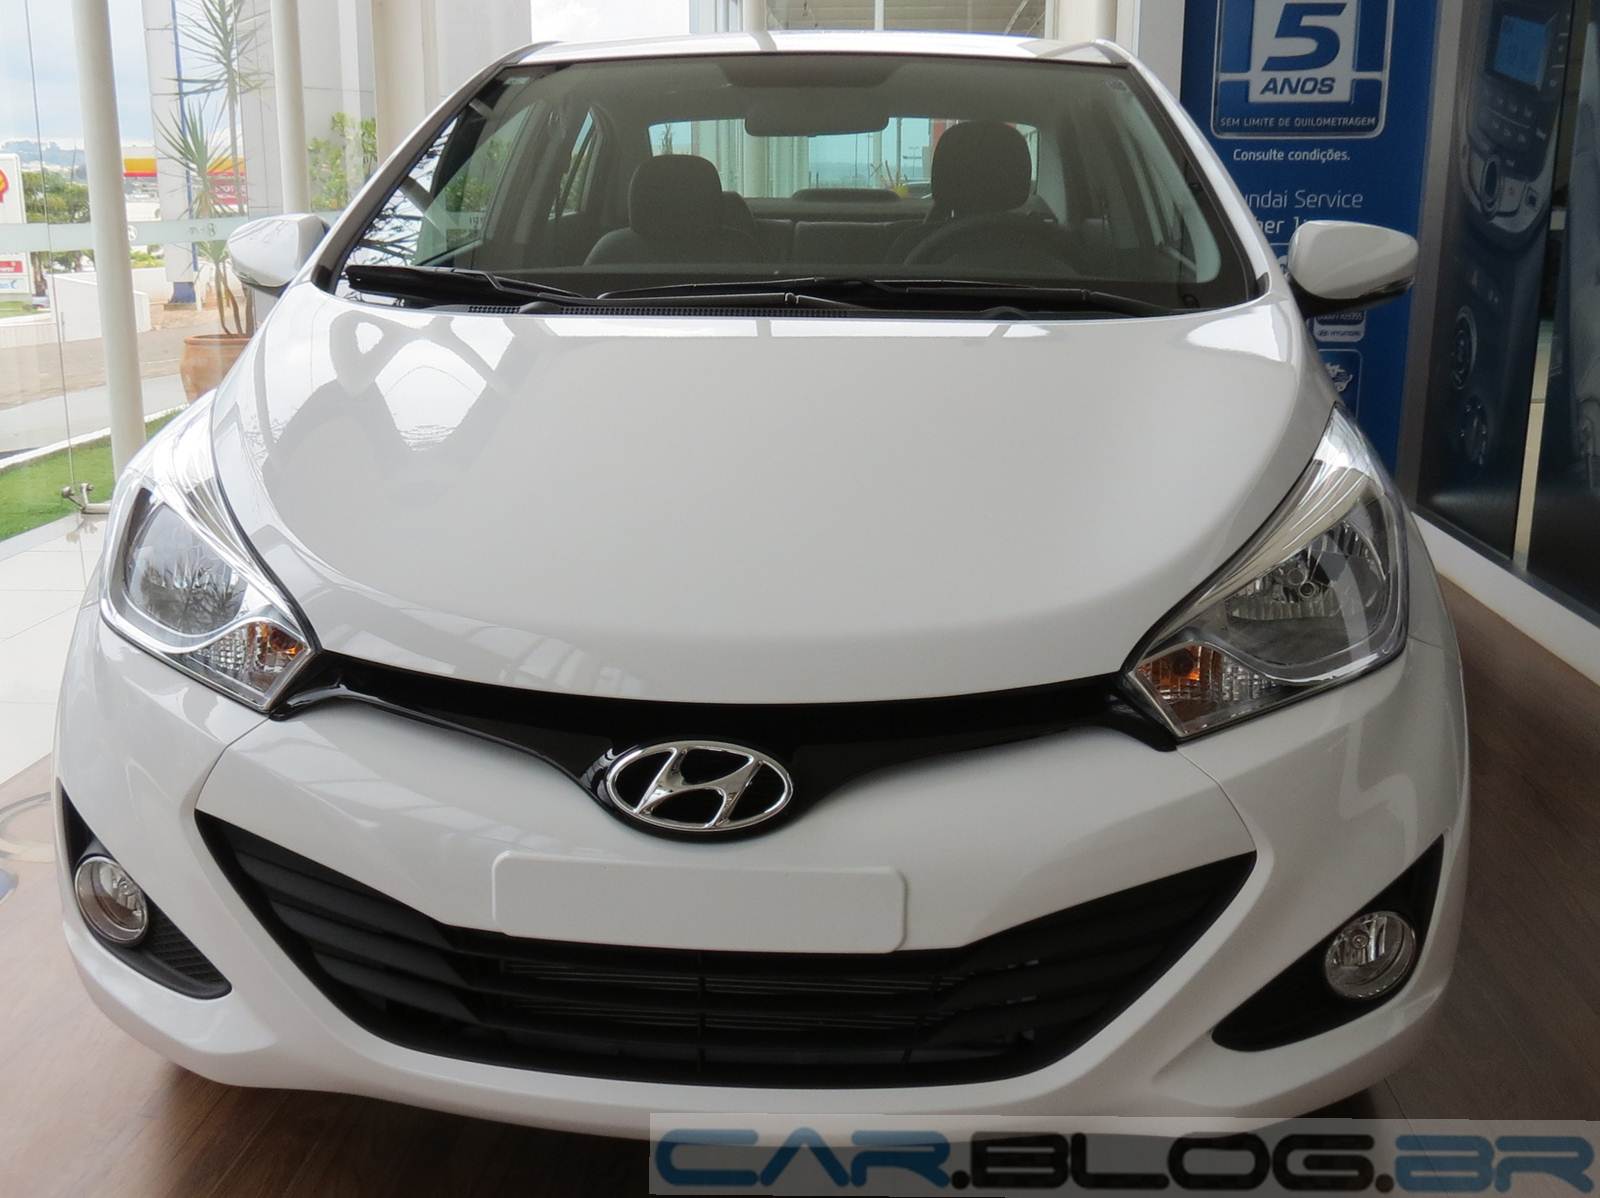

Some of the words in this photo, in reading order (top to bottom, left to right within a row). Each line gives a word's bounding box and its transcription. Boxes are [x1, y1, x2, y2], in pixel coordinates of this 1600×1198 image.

[1261, 3, 1347, 71] 5
[1260, 77, 1336, 95] ANOS
[1220, 117, 1240, 127] SEM
[1244, 117, 1275, 127] LIMITE
[1278, 117, 1291, 127] DE
[1294, 116, 1376, 127] QUILOMETRAGEM
[1233, 149, 1284, 161] Consulte
[1288, 149, 1351, 163] condições.
[1294, 189, 1364, 208] Service
